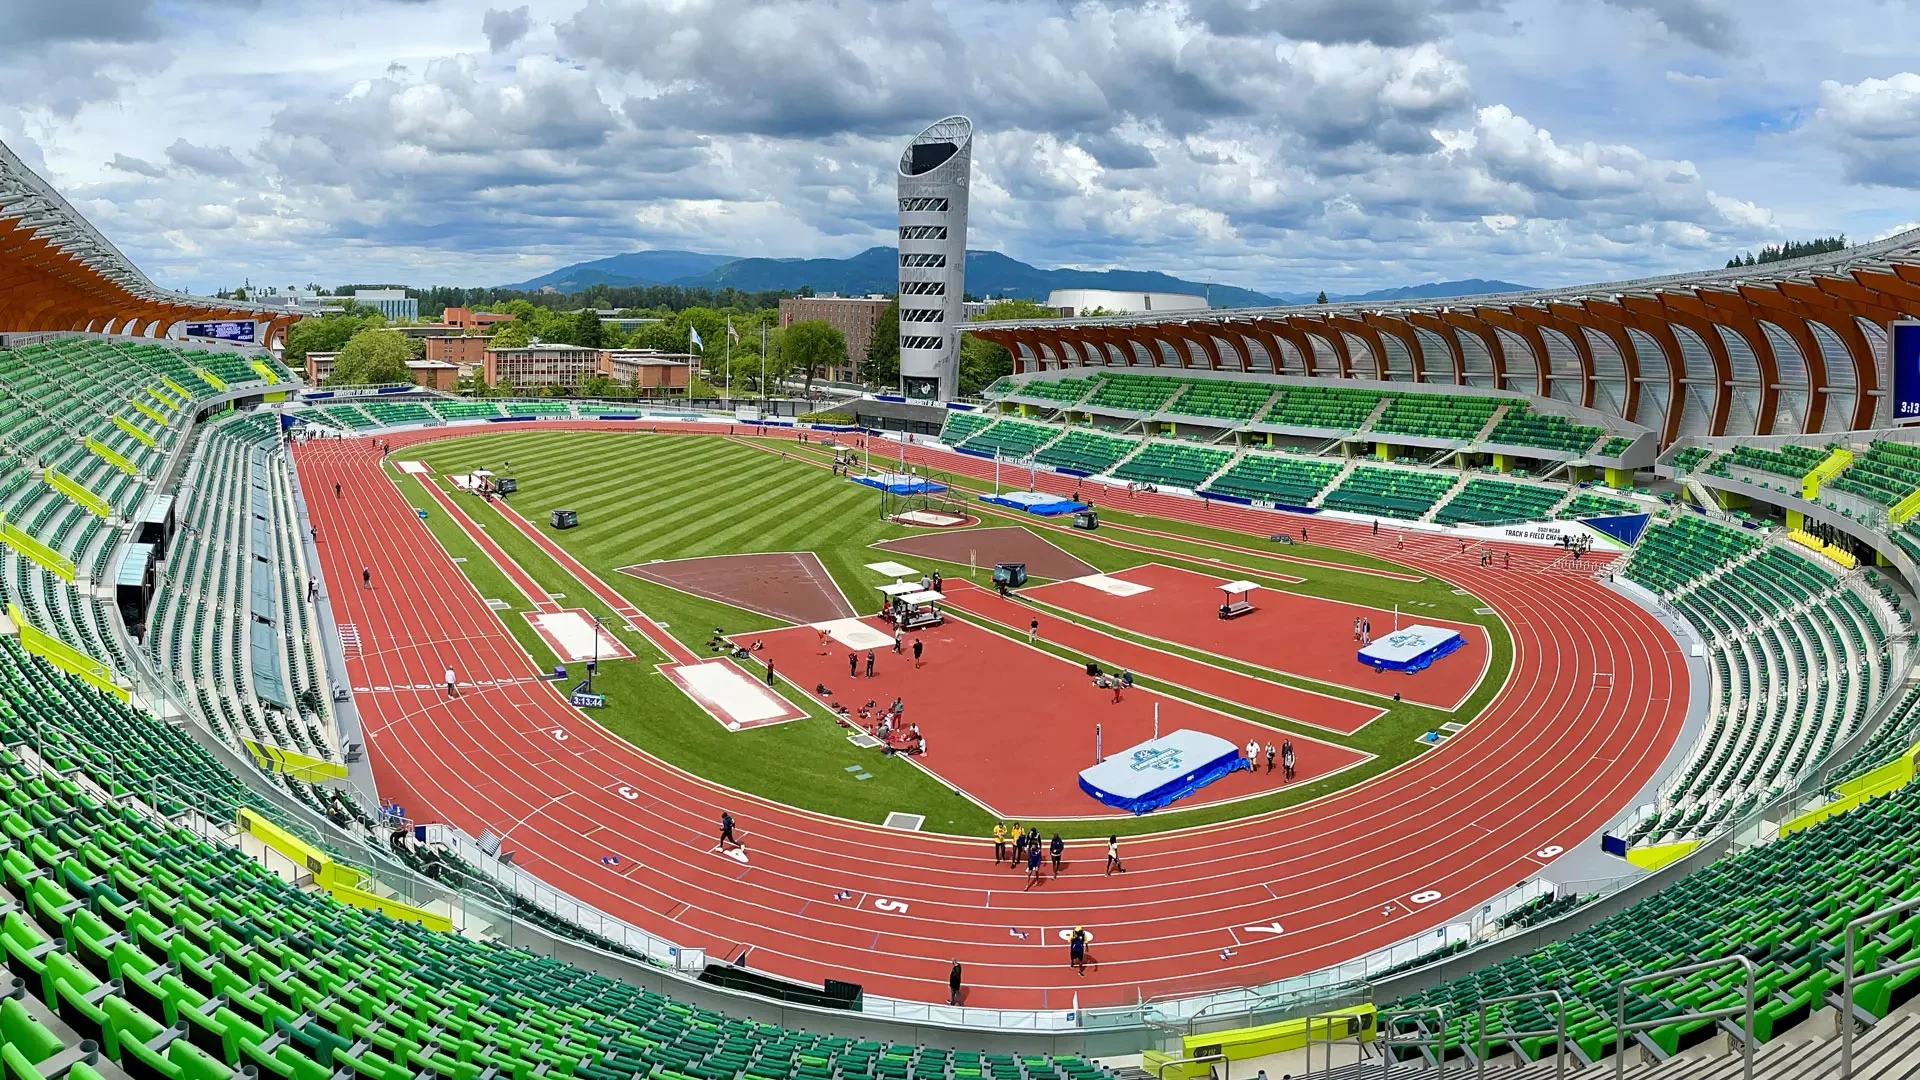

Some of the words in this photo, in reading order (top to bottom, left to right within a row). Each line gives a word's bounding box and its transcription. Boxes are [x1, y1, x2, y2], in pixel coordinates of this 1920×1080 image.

[1901, 401, 1920, 414] 3:13
[1505, 529, 1523, 537] TRACK
[1530, 532, 1545, 540] FIELD
[551, 729, 569, 741] 2
[618, 786, 639, 799] 3
[1410, 890, 1442, 904] 8
[874, 898, 909, 914] 5
[1244, 921, 1284, 934] 7
